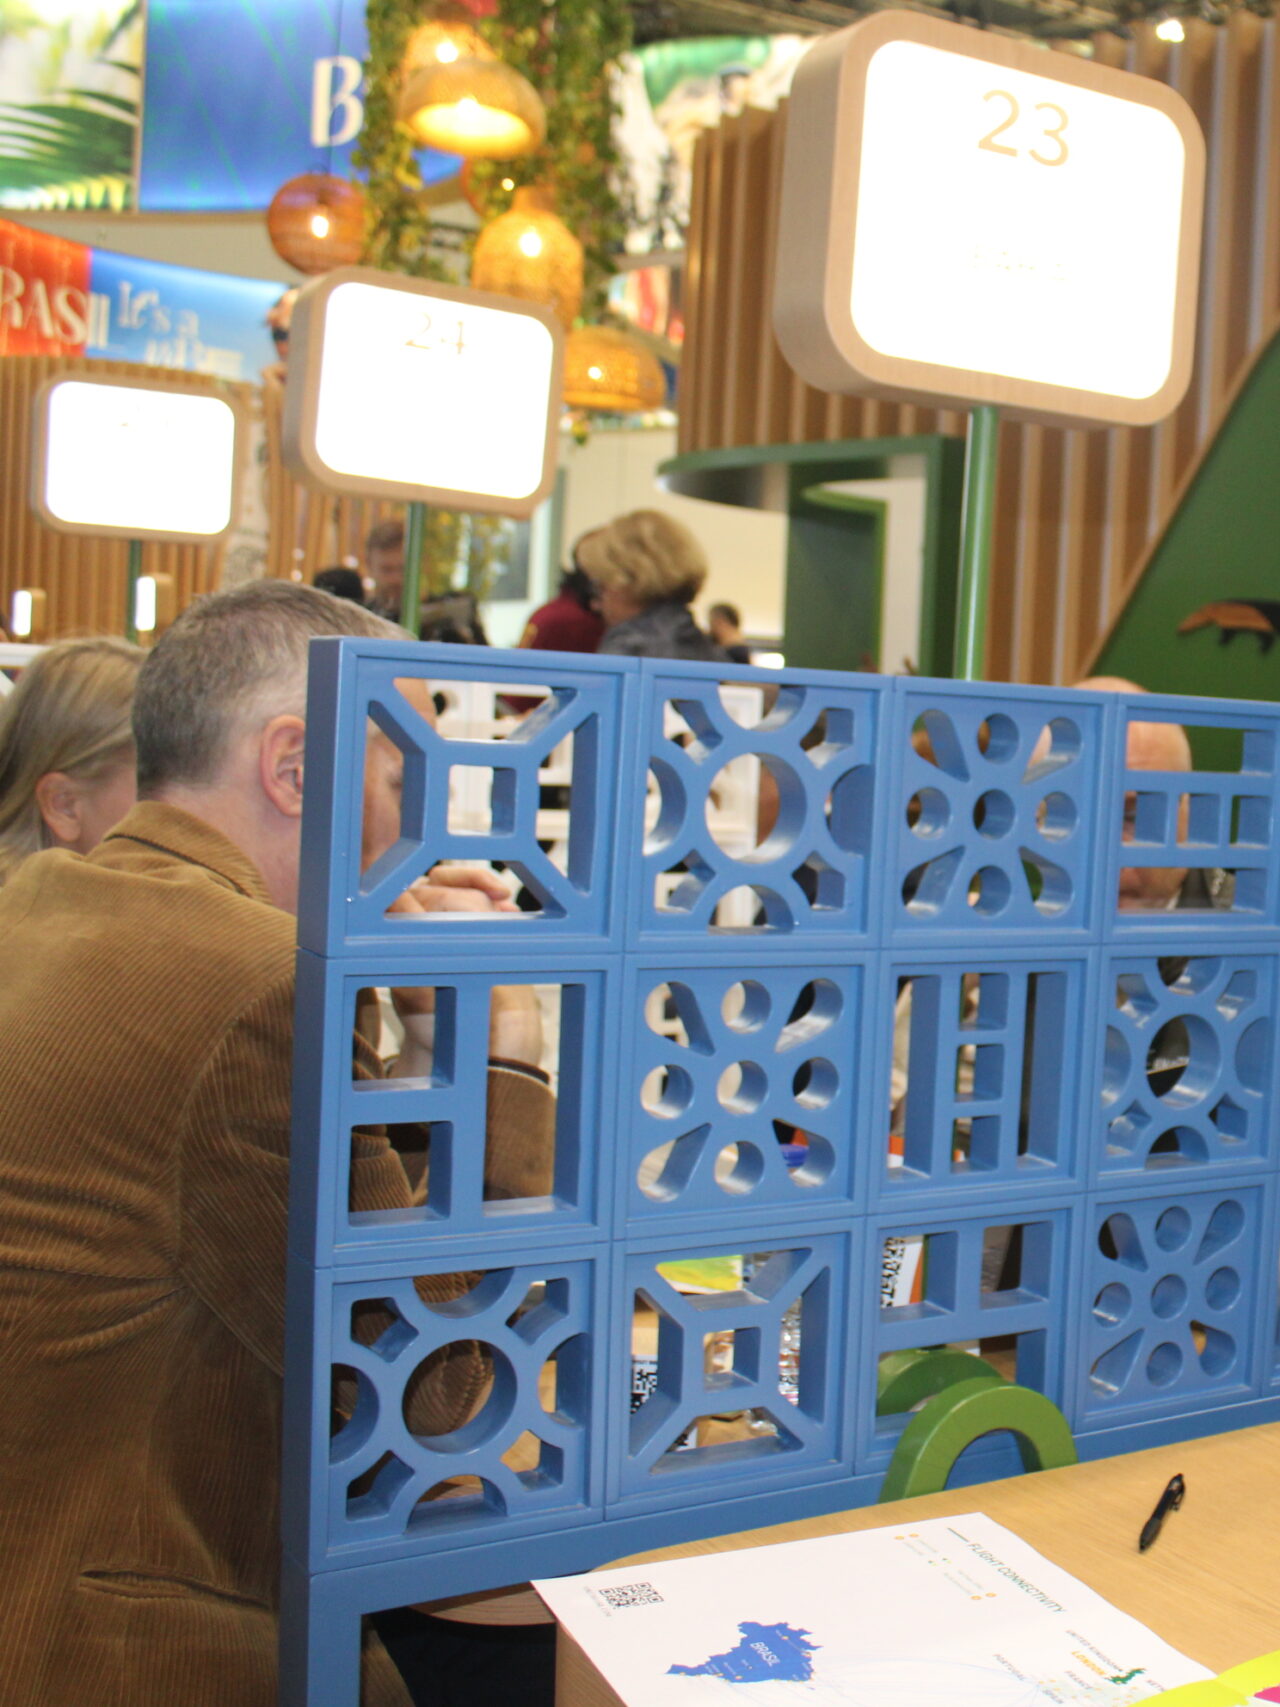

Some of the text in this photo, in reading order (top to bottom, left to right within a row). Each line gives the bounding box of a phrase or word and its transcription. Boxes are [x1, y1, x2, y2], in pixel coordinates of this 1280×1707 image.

[978, 89, 1070, 167] 23
[968, 1542, 1004, 1567] FLIGHT
[998, 1565, 1068, 1613] CONNECTIVITY
[750, 1640, 782, 1668] BRASIL
